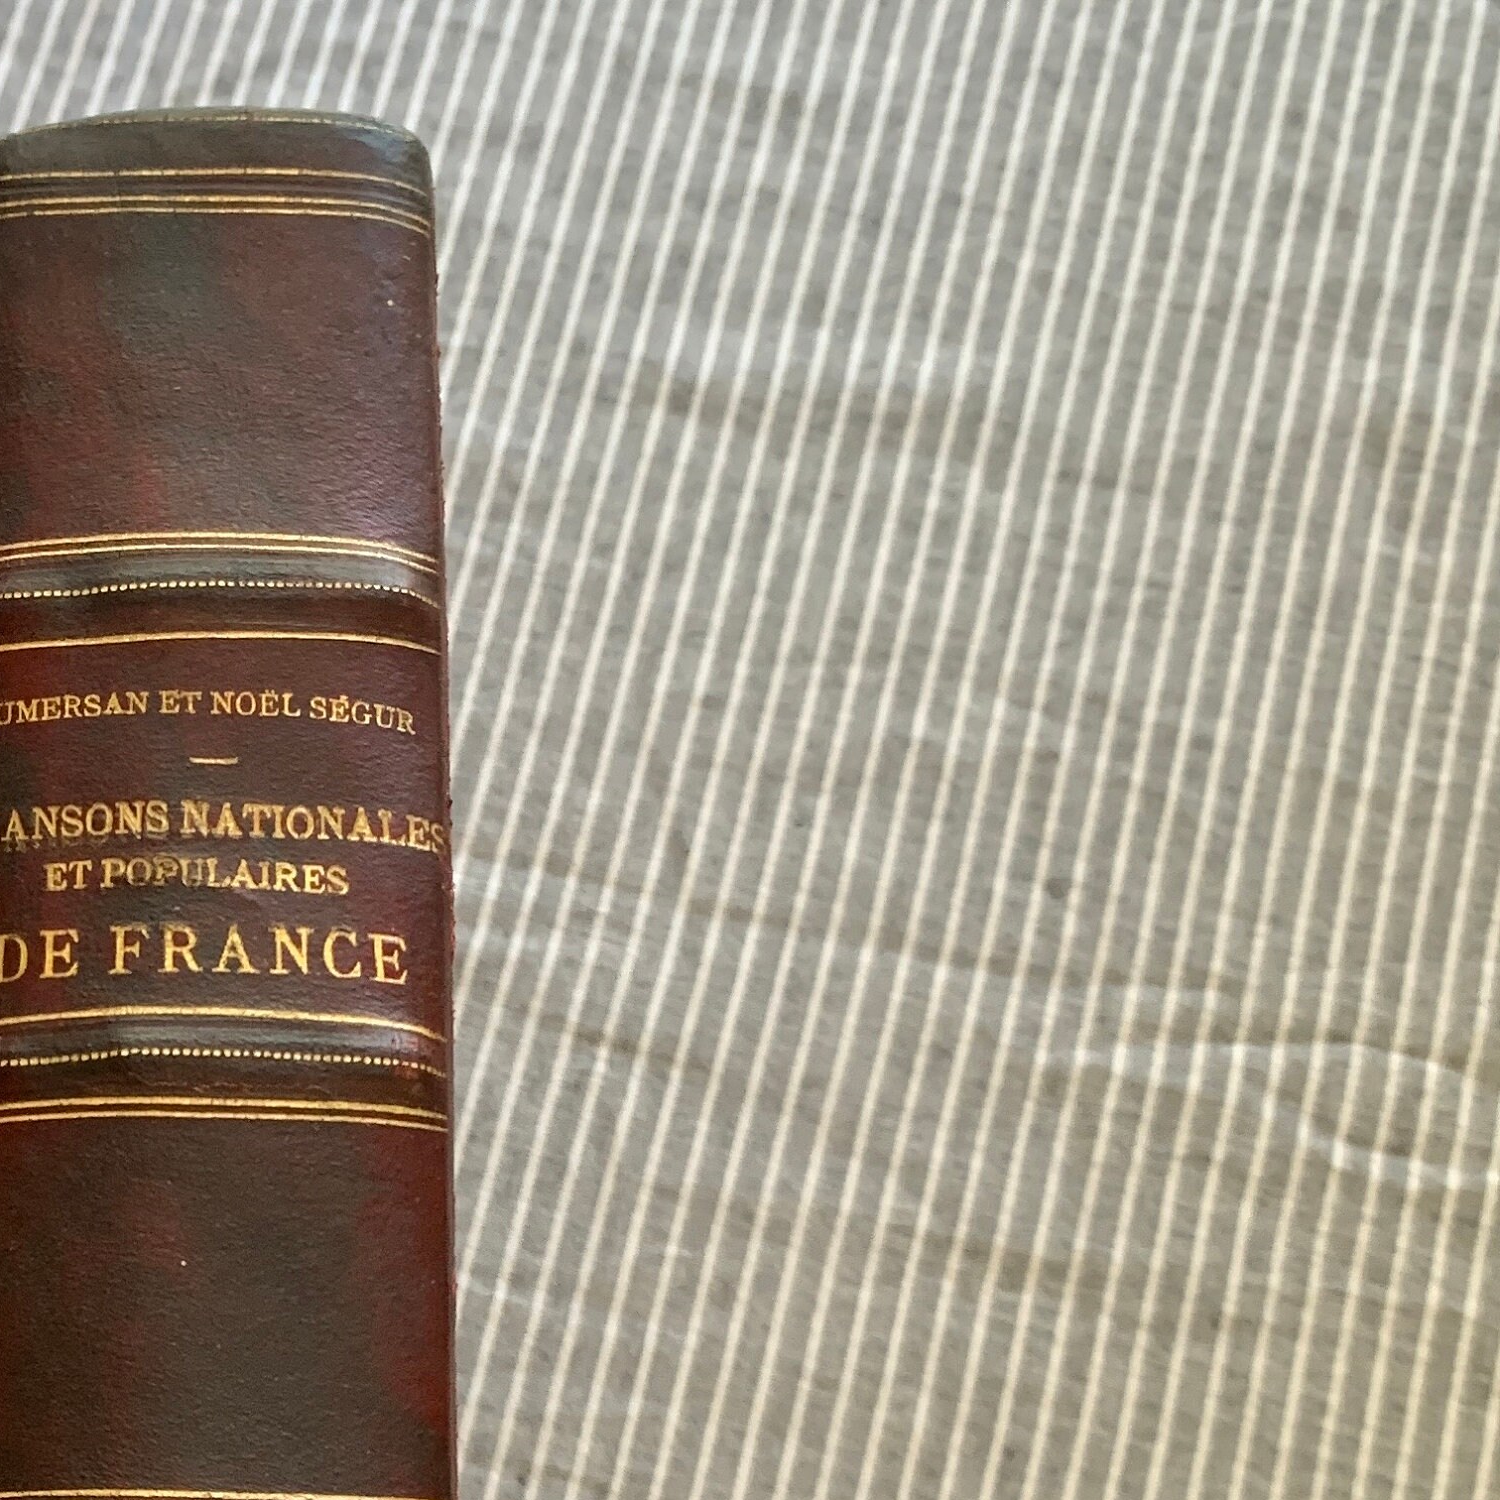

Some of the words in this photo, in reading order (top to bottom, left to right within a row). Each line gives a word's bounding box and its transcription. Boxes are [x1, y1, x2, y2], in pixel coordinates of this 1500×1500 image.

[158, 689, 202, 714] ET
[211, 689, 301, 717] NOËL
[309, 694, 416, 735] SÉGUR
[181, 800, 447, 854] NATIONALES
[44, 859, 92, 892] ET
[99, 858, 349, 895] POPULAIRES
[107, 923, 409, 985] FRANCE
